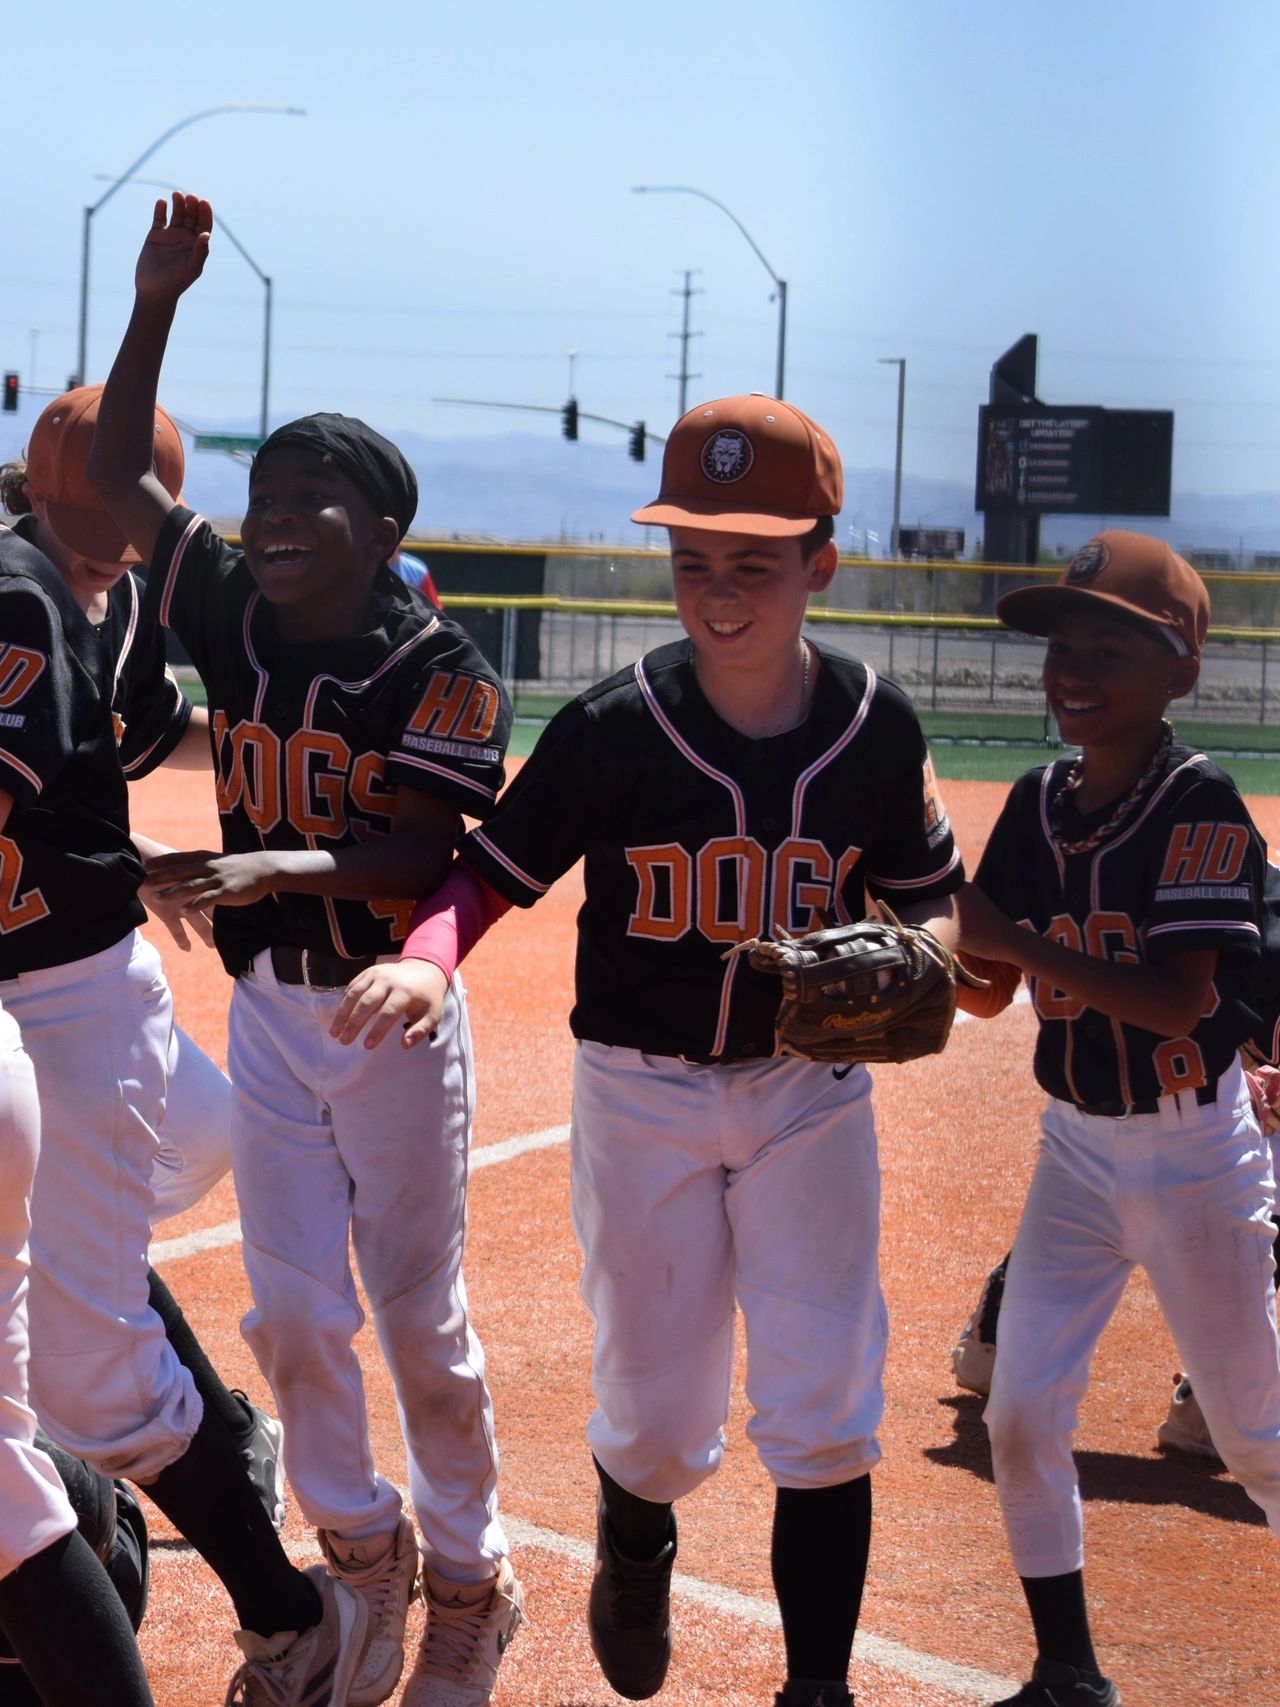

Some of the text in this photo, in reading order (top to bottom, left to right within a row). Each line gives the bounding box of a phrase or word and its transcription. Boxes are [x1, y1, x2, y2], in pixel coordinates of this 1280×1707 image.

[405, 671, 500, 742] HD
[402, 734, 500, 761] BASEBALL CLUB
[1157, 822, 1251, 886] HD
[1155, 887, 1250, 902] BASEBALL CLUB
